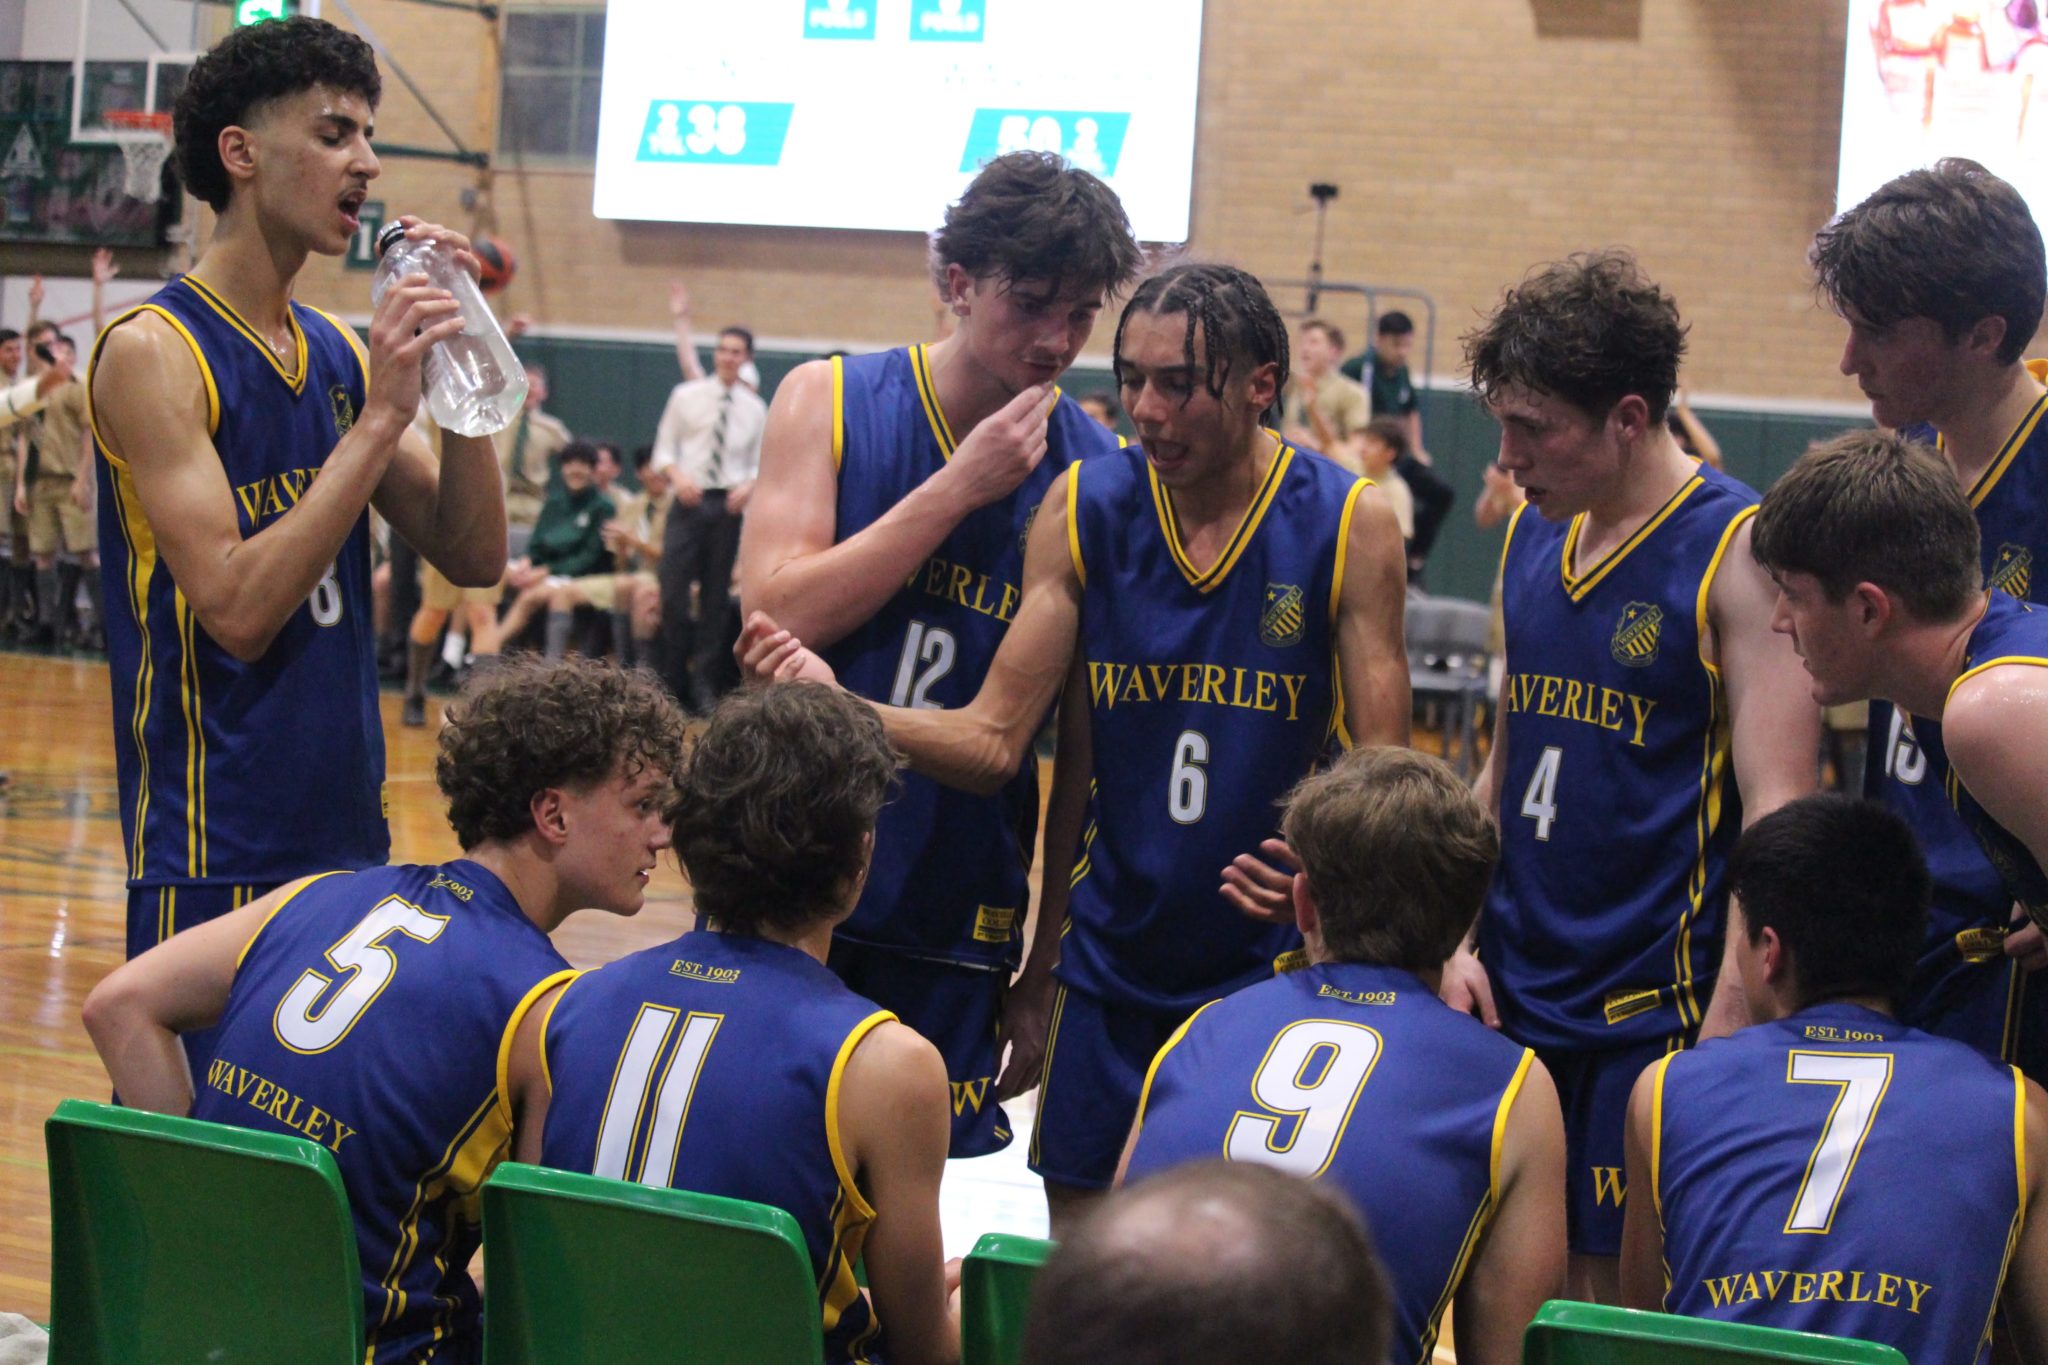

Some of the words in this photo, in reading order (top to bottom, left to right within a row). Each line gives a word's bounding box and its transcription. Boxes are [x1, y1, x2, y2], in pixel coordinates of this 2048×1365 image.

[889, 619, 957, 709] 12
[1088, 661, 1307, 721] WAVERLEY
[1507, 673, 1657, 747] AVERLEY
[1168, 729, 1210, 825] 6
[1520, 745, 1563, 842] 4
[273, 893, 451, 1055] 5
[669, 959, 703, 974] EST.
[706, 966, 741, 982] 1903
[1358, 991, 1397, 1004] 1903
[1804, 1025, 1840, 1038] EST.
[207, 1058, 357, 1153] WAVERLEY
[592, 1002, 725, 1188] 11
[1223, 1018, 1384, 1180] 9
[1783, 1049, 1894, 1234] 7
[1702, 1270, 1932, 1324] WAVERLEY
